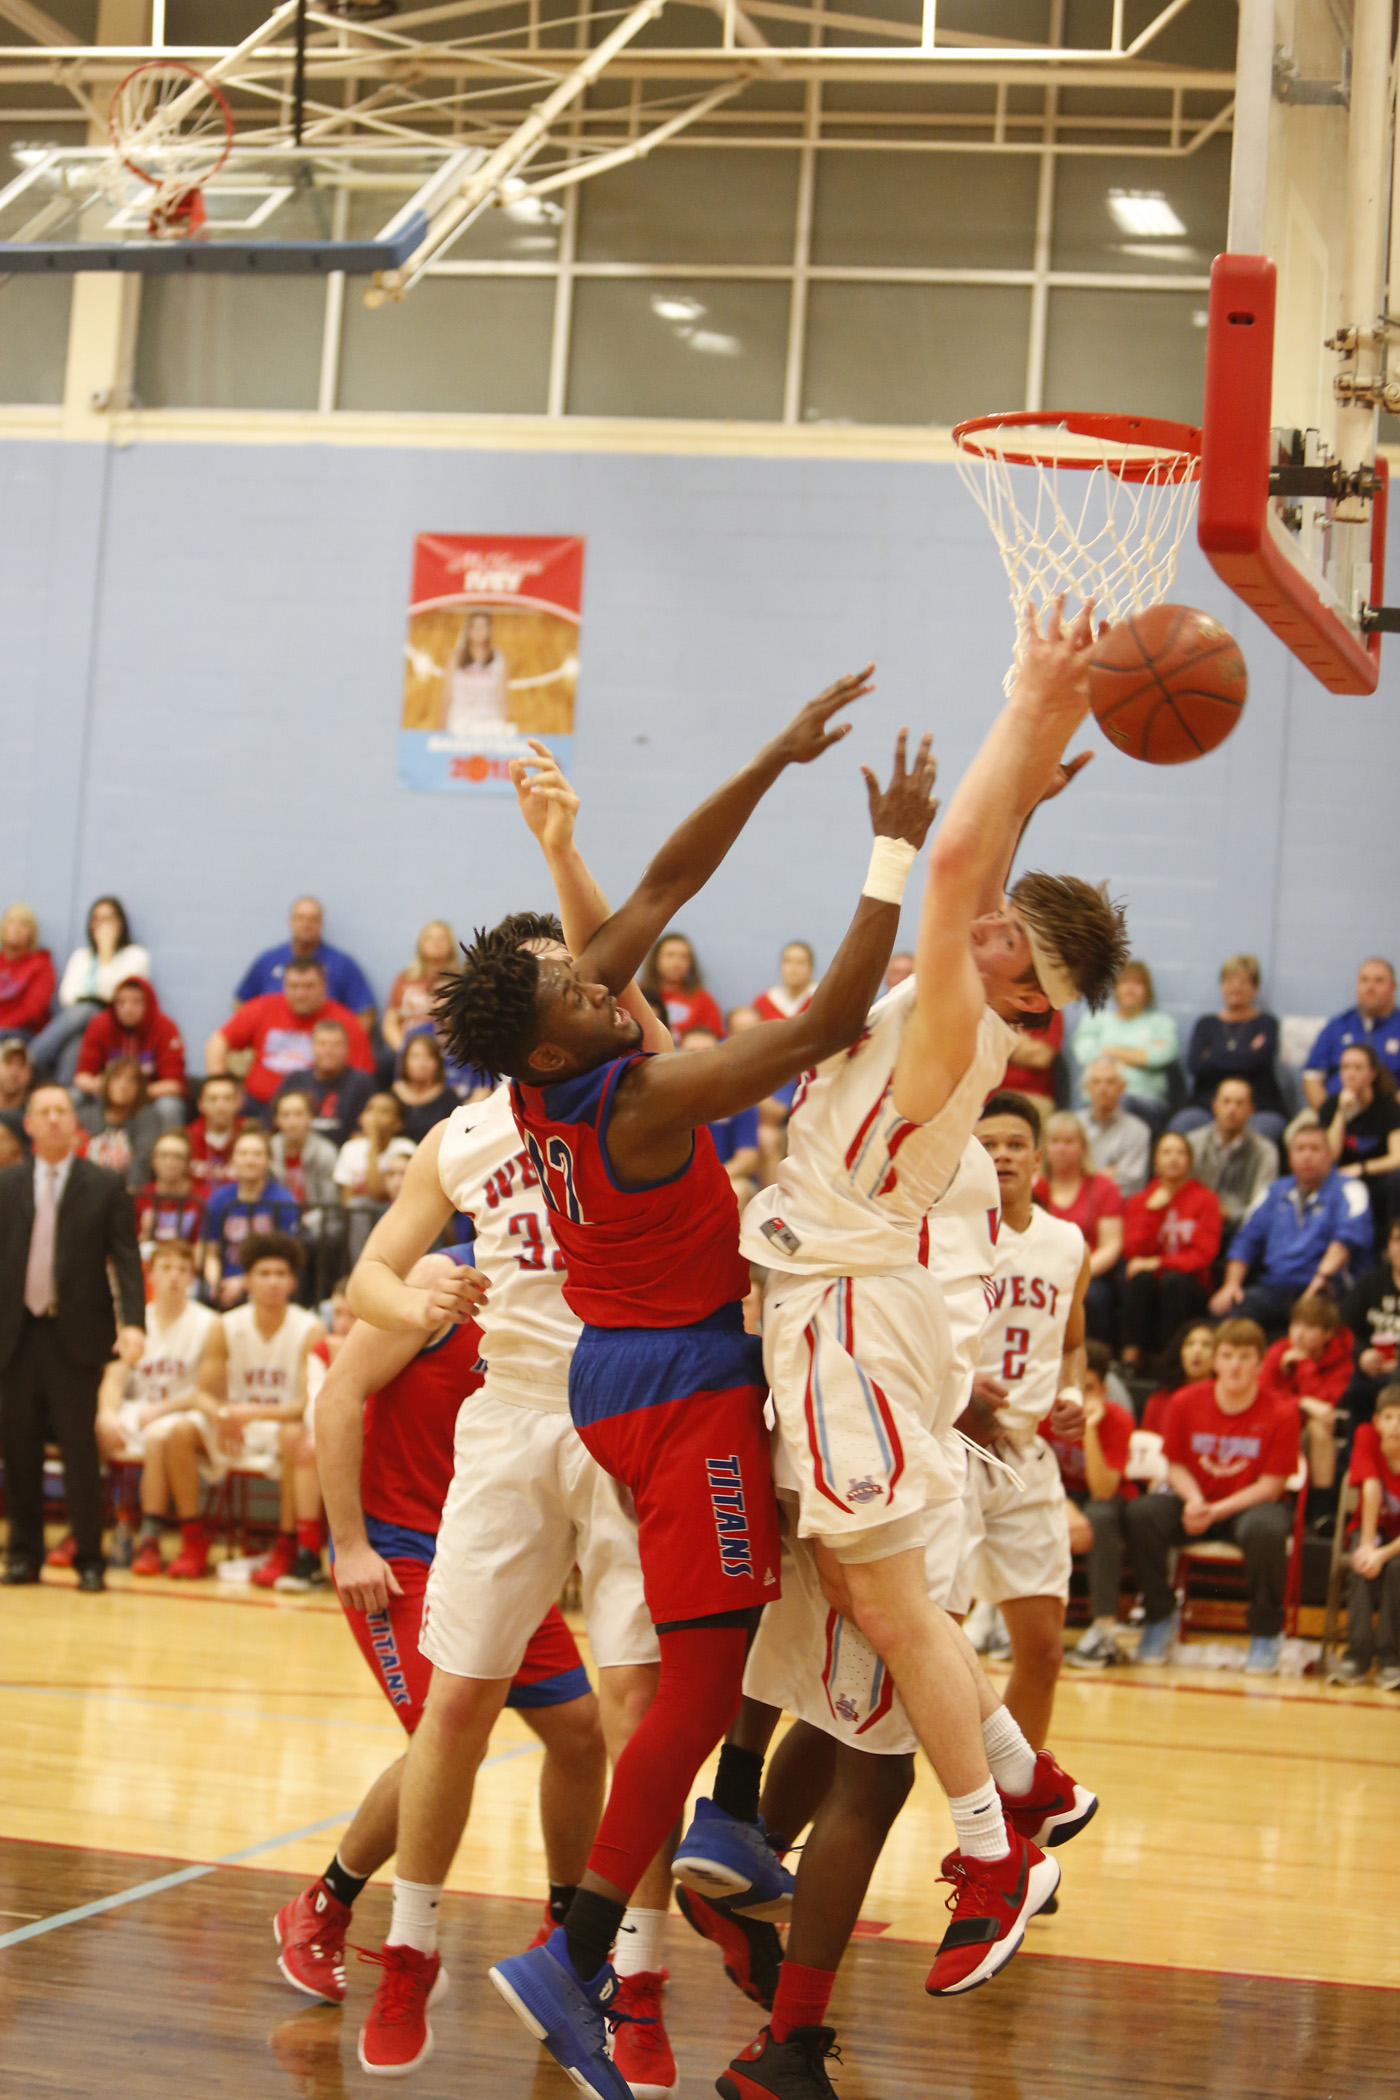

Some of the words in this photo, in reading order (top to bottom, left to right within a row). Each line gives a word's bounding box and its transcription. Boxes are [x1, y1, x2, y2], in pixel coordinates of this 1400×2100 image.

[482, 1149, 541, 1209] WE
[1002, 1326, 1030, 1380] 2
[705, 1454, 754, 1580] TITANS
[366, 1608, 412, 1706] TITANS
